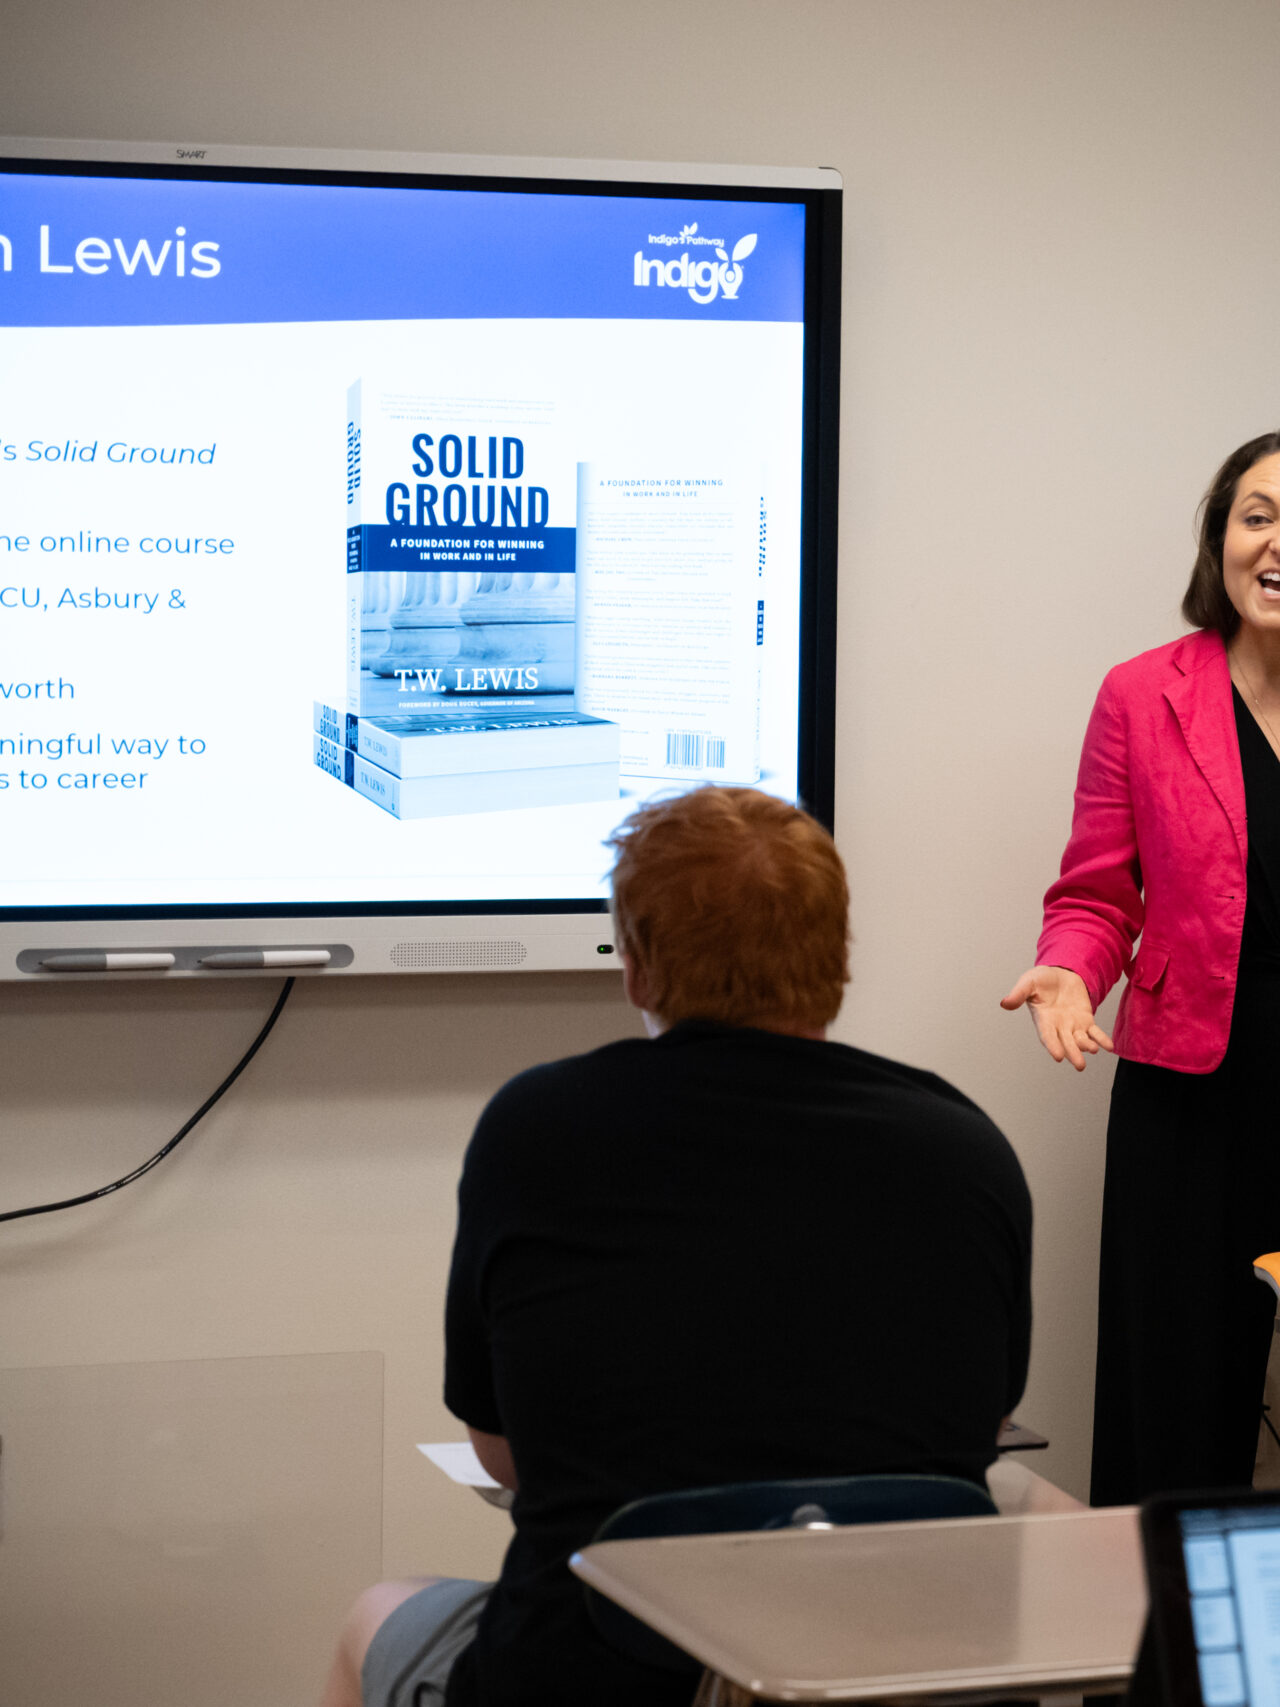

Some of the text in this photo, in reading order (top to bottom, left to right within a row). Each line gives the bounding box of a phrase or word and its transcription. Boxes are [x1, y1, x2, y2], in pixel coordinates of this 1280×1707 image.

[176, 149, 207, 159] SMART
[40, 224, 221, 278] Lewis
[687, 236, 725, 248] Pathway
[633, 251, 744, 305] Indigo
[25, 440, 98, 462] Solid
[107, 443, 216, 464] Ground
[412, 433, 524, 479] SOLID
[684, 479, 724, 487] WINNING
[386, 482, 549, 527] GROUND
[40, 531, 130, 553] online
[139, 537, 235, 555] course
[390, 538, 545, 550] A FOUNDATION FOR WINNING
[420, 552, 517, 561] IN WORK AND IN LIFE
[0, 587, 187, 614] CU, Asbury &
[394, 667, 539, 692] T.W. LEWIS
[0, 733, 206, 760] ningful way to
[0, 770, 149, 789] s to career
